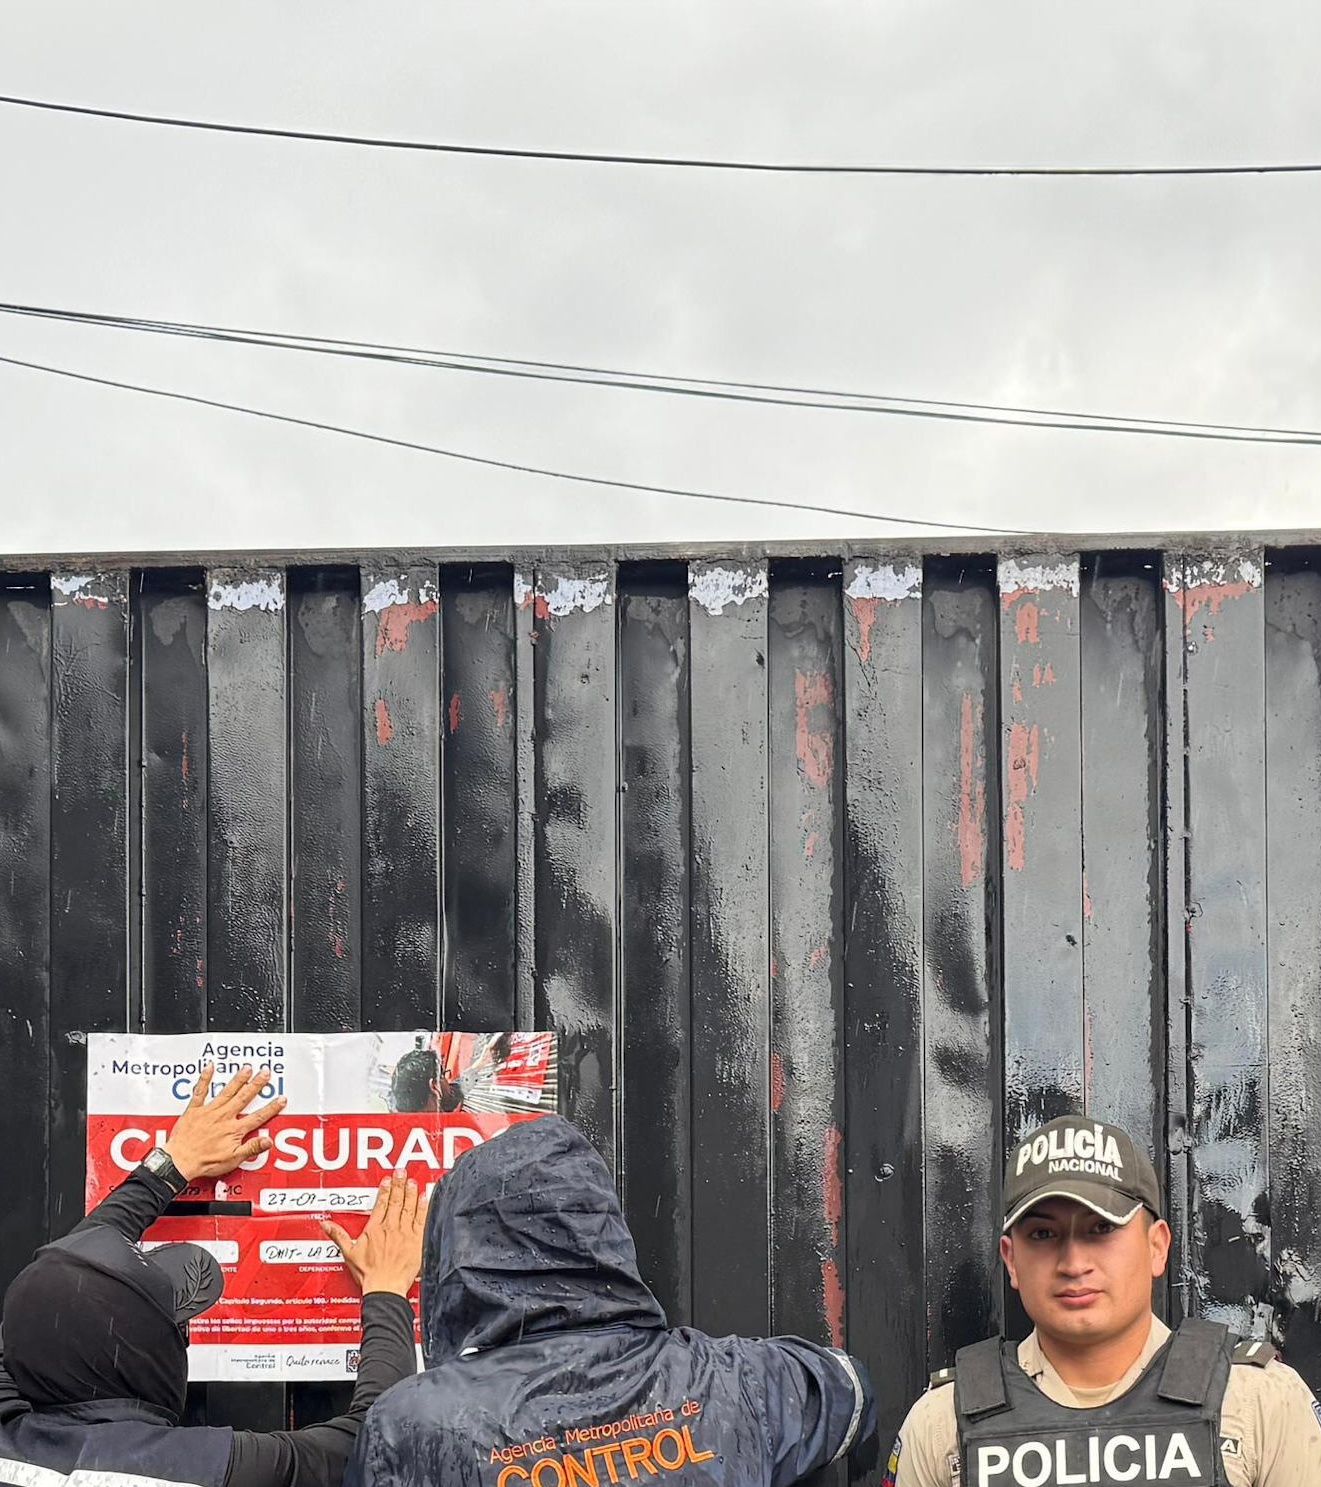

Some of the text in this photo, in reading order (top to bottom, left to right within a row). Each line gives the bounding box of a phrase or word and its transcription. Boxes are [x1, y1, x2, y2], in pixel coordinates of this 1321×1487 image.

[202, 1041, 285, 1060] Agencia
[1016, 1124, 1124, 1176] POLICÍA
[1048, 1158, 1123, 1182] NACIONAL
[299, 1265, 344, 1273] DEPENDENCIA
[490, 1399, 702, 1465] Agencia Metropolitana de
